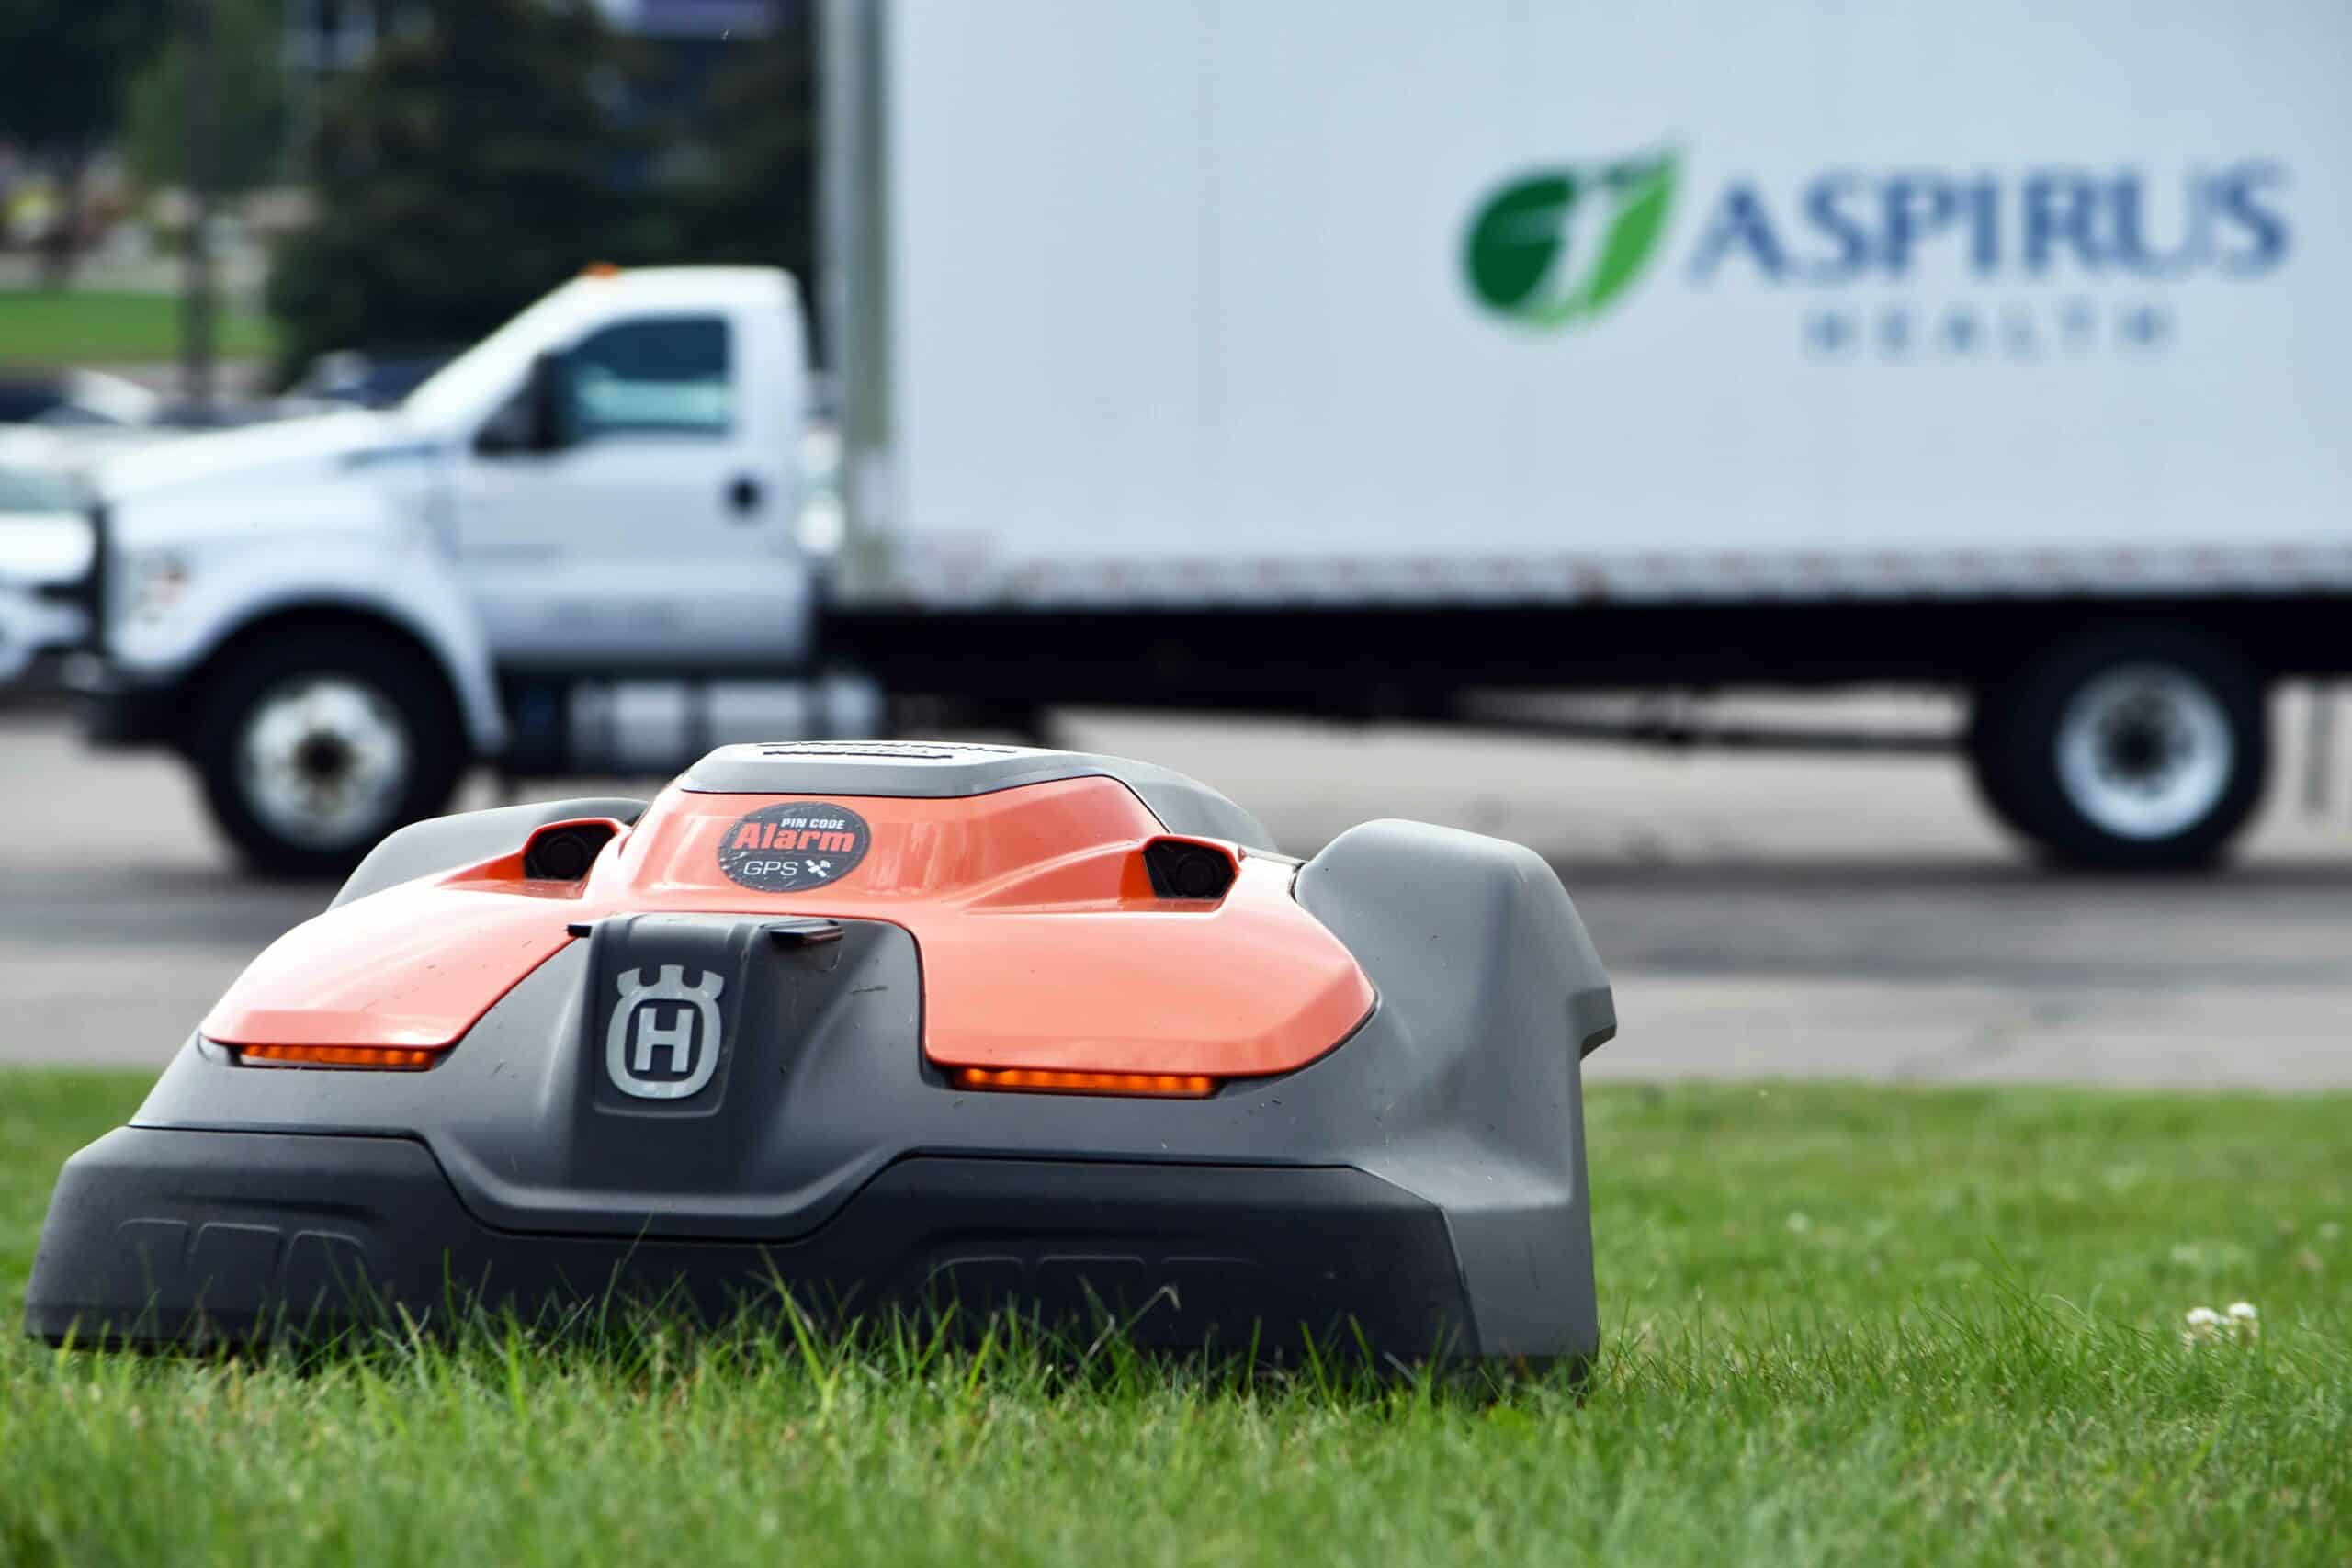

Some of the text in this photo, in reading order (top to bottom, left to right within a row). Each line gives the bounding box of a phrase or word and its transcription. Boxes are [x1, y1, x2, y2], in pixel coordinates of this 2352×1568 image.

[1689, 162, 2291, 283] ASPIRUS
[781, 818, 845, 829] PIN CODE
[731, 822, 856, 852] Alarm
[742, 860, 799, 876] GPS
